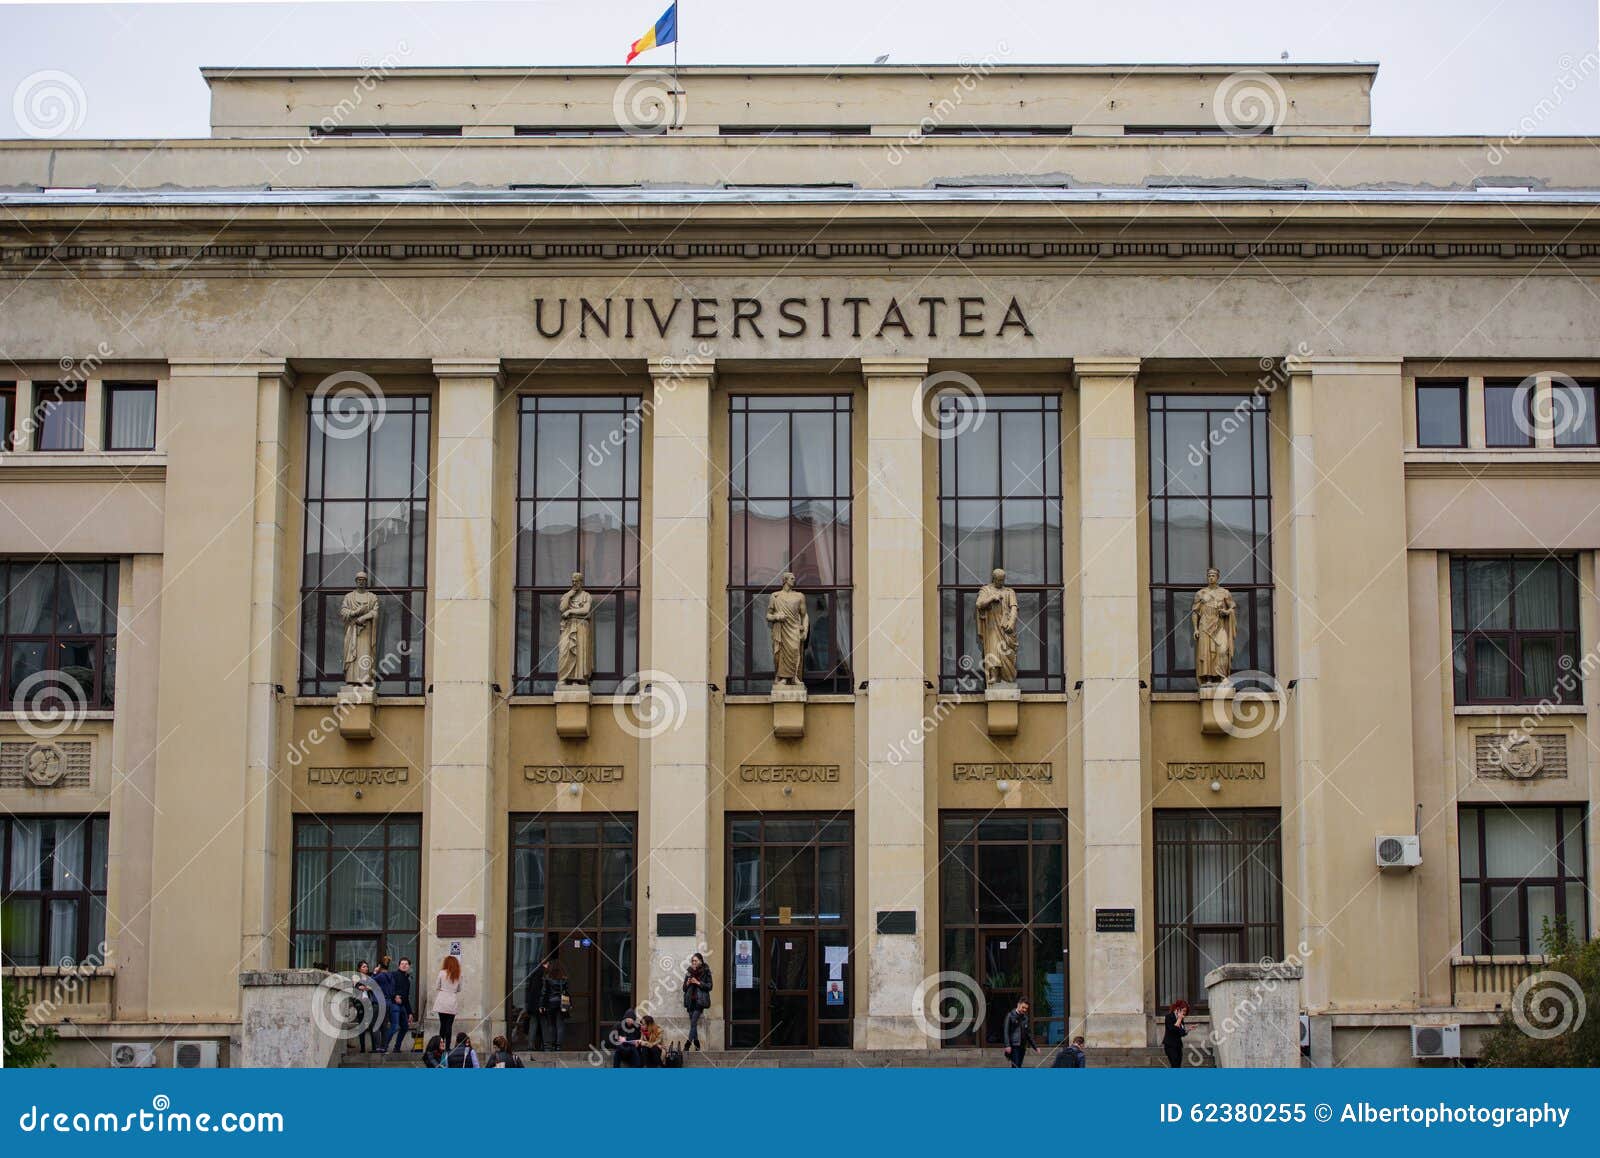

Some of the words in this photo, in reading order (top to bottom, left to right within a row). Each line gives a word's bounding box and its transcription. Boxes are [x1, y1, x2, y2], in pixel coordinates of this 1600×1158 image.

[535, 297, 1034, 338] UNIVERSITATEA
[535, 766, 613, 783] SOLONE
[740, 765, 840, 782] CICERONE
[953, 763, 1052, 781] PAPINIAN
[1168, 763, 1265, 780] IUSTINIAN
